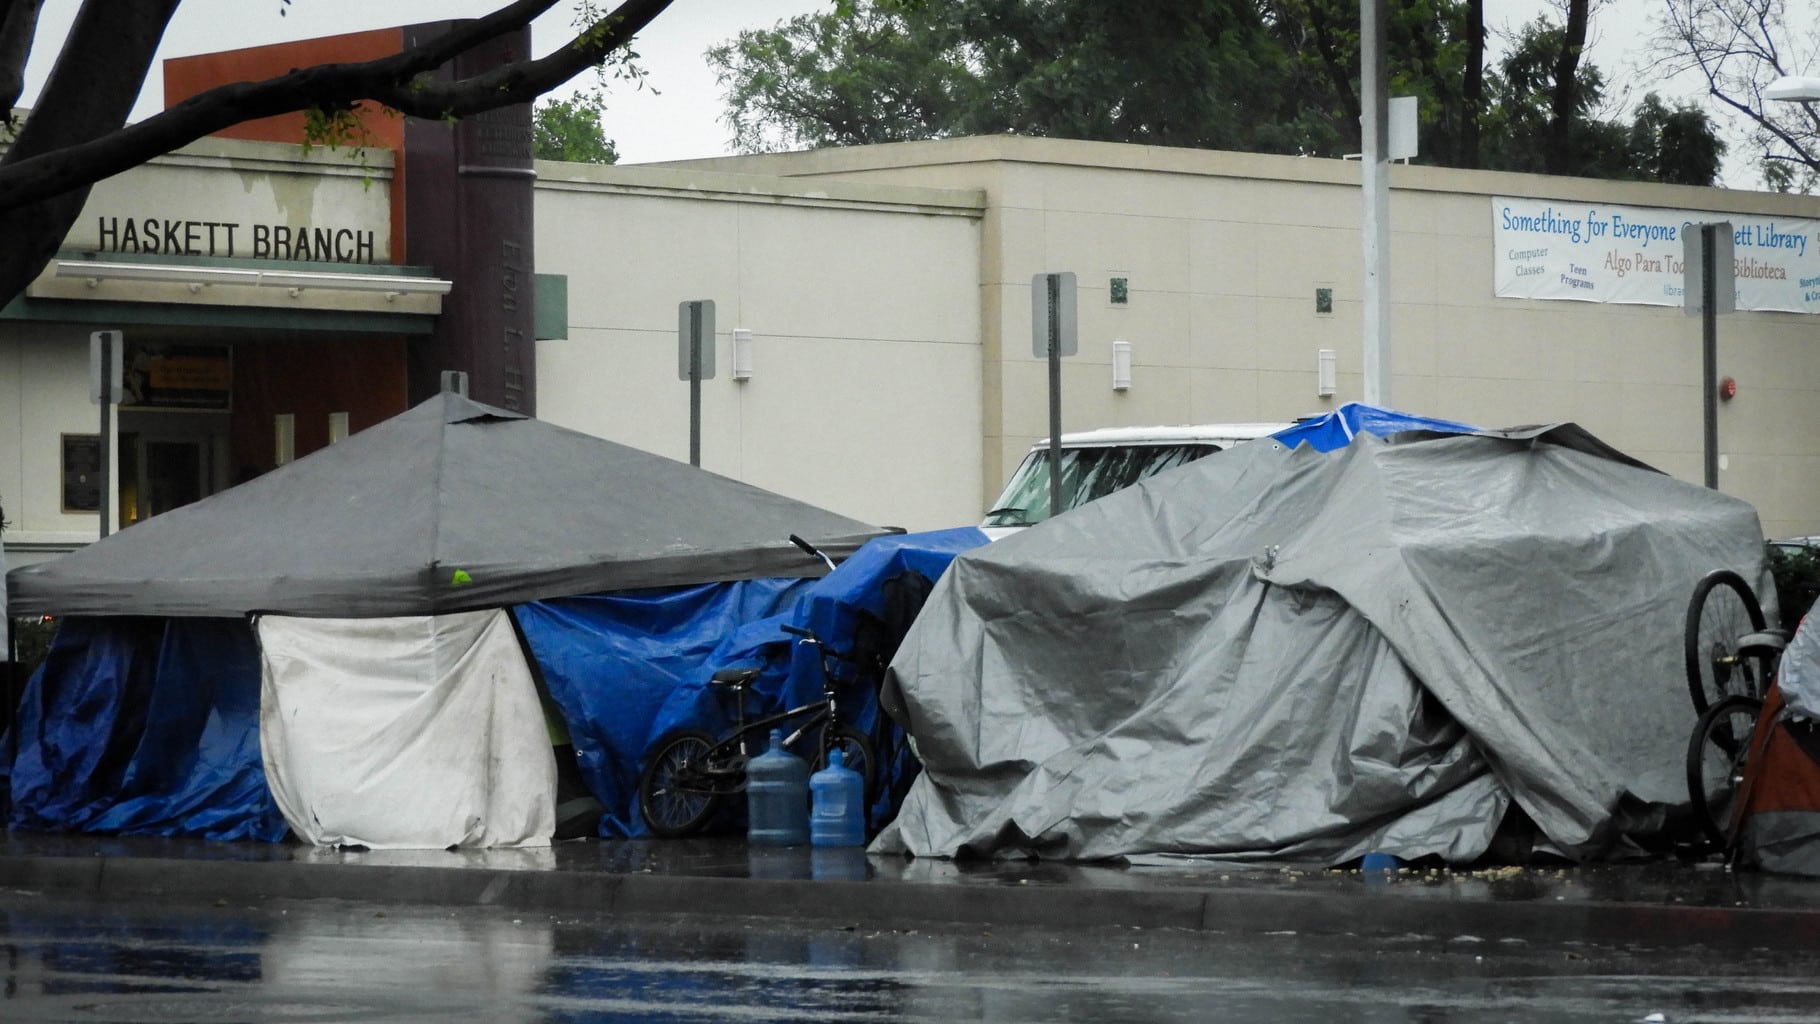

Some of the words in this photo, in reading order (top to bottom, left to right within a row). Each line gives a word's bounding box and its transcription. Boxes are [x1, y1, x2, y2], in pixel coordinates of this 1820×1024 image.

[99, 216, 239, 258] HASKETT
[253, 224, 374, 264] BRANCH
[1503, 207, 1581, 244] Something
[1584, 210, 1608, 244] for
[1612, 215, 1676, 247] Everyone
[1757, 222, 1807, 257] Library
[1508, 248, 1549, 262] Computer
[1515, 265, 1545, 277] Classes
[1569, 264, 1587, 276] Teen
[1604, 249, 1632, 278] Algo
[1635, 252, 1662, 273] Para
[1734, 256, 1787, 281] Biblioteca
[1560, 273, 1594, 290] Programs
